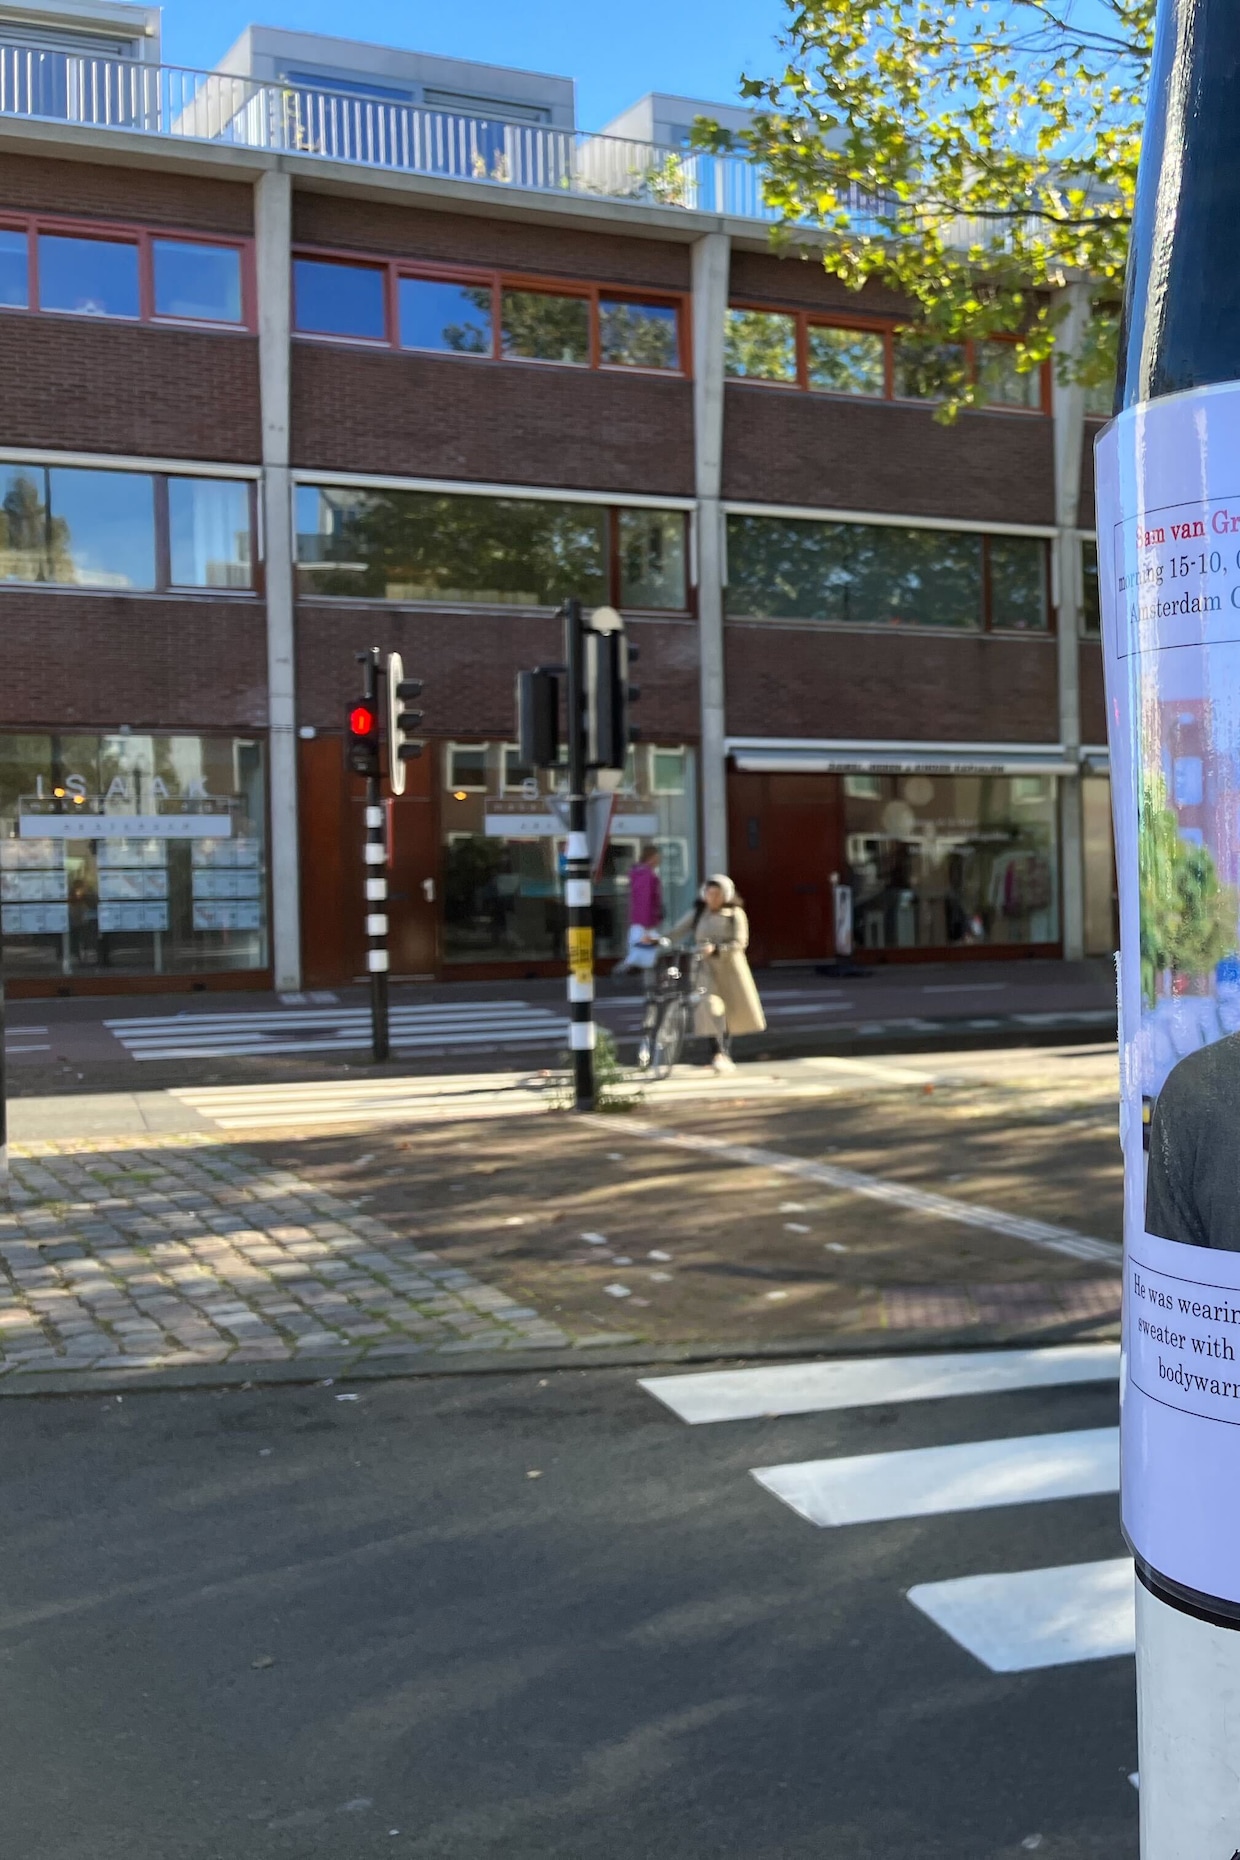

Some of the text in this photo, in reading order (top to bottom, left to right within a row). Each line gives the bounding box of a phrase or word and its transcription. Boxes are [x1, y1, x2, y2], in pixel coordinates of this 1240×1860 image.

[1136, 526, 1165, 548] Sam
[1170, 521, 1205, 541] van
[1118, 565, 1164, 593] morning
[1170, 551, 1227, 579] 15-10,
[1130, 592, 1222, 624] Amsterdam
[35, 773, 210, 800] ISAAK
[1134, 1273, 1146, 1299] He
[1148, 1288, 1174, 1310] was
[1138, 1317, 1186, 1350] sweater
[1191, 1335, 1235, 1361] with
